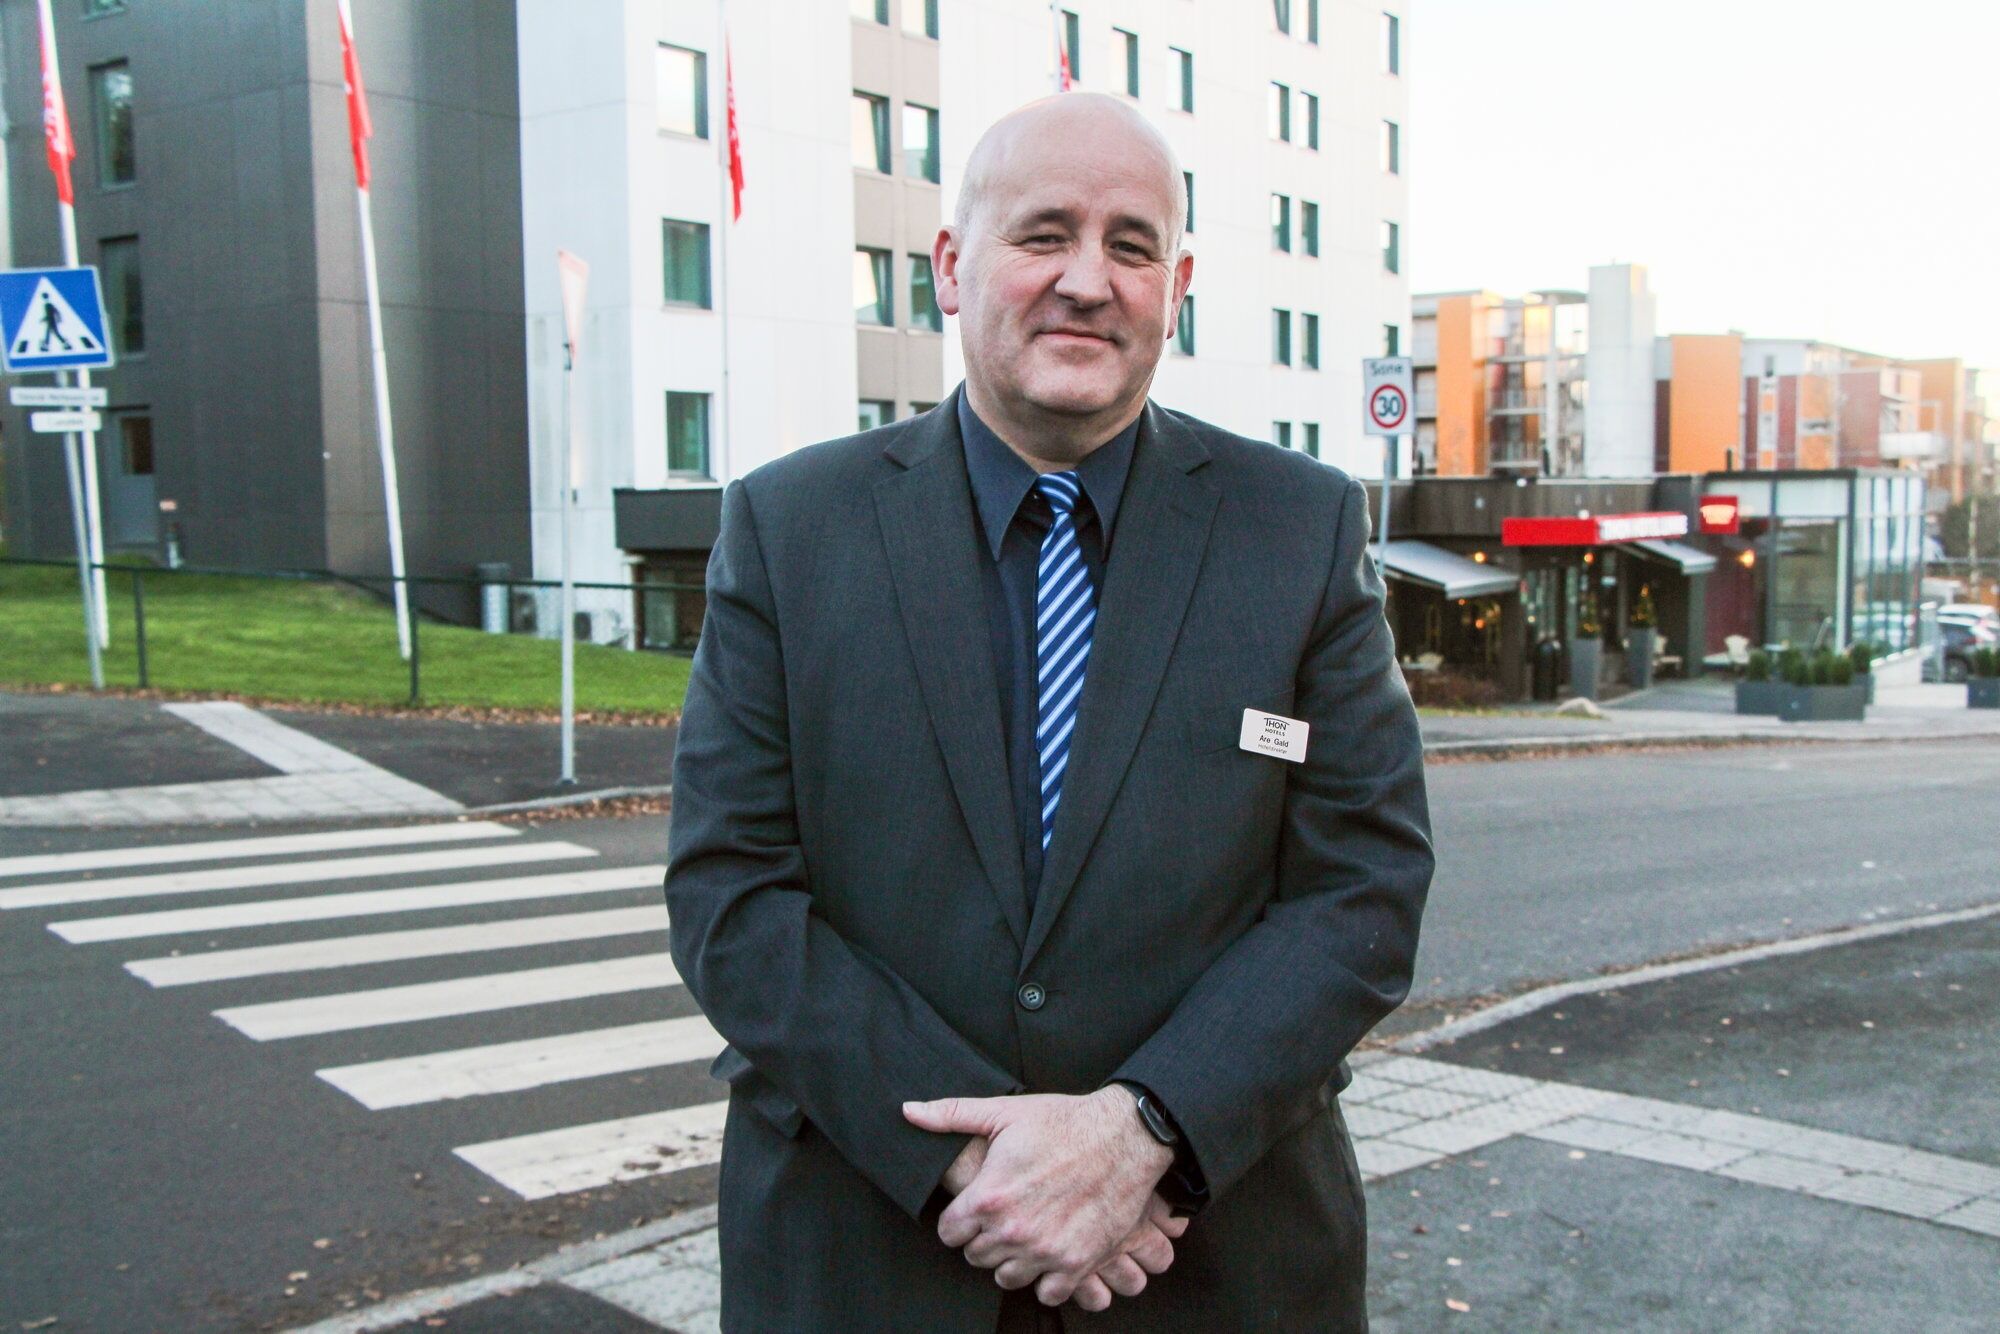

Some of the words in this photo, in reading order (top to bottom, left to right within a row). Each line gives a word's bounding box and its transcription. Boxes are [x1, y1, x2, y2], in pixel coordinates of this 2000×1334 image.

[1377, 396, 1401, 417] 30
[1264, 717, 1290, 731] THON
[1265, 728, 1286, 737] HOTELS
[1259, 735, 1271, 744] Are
